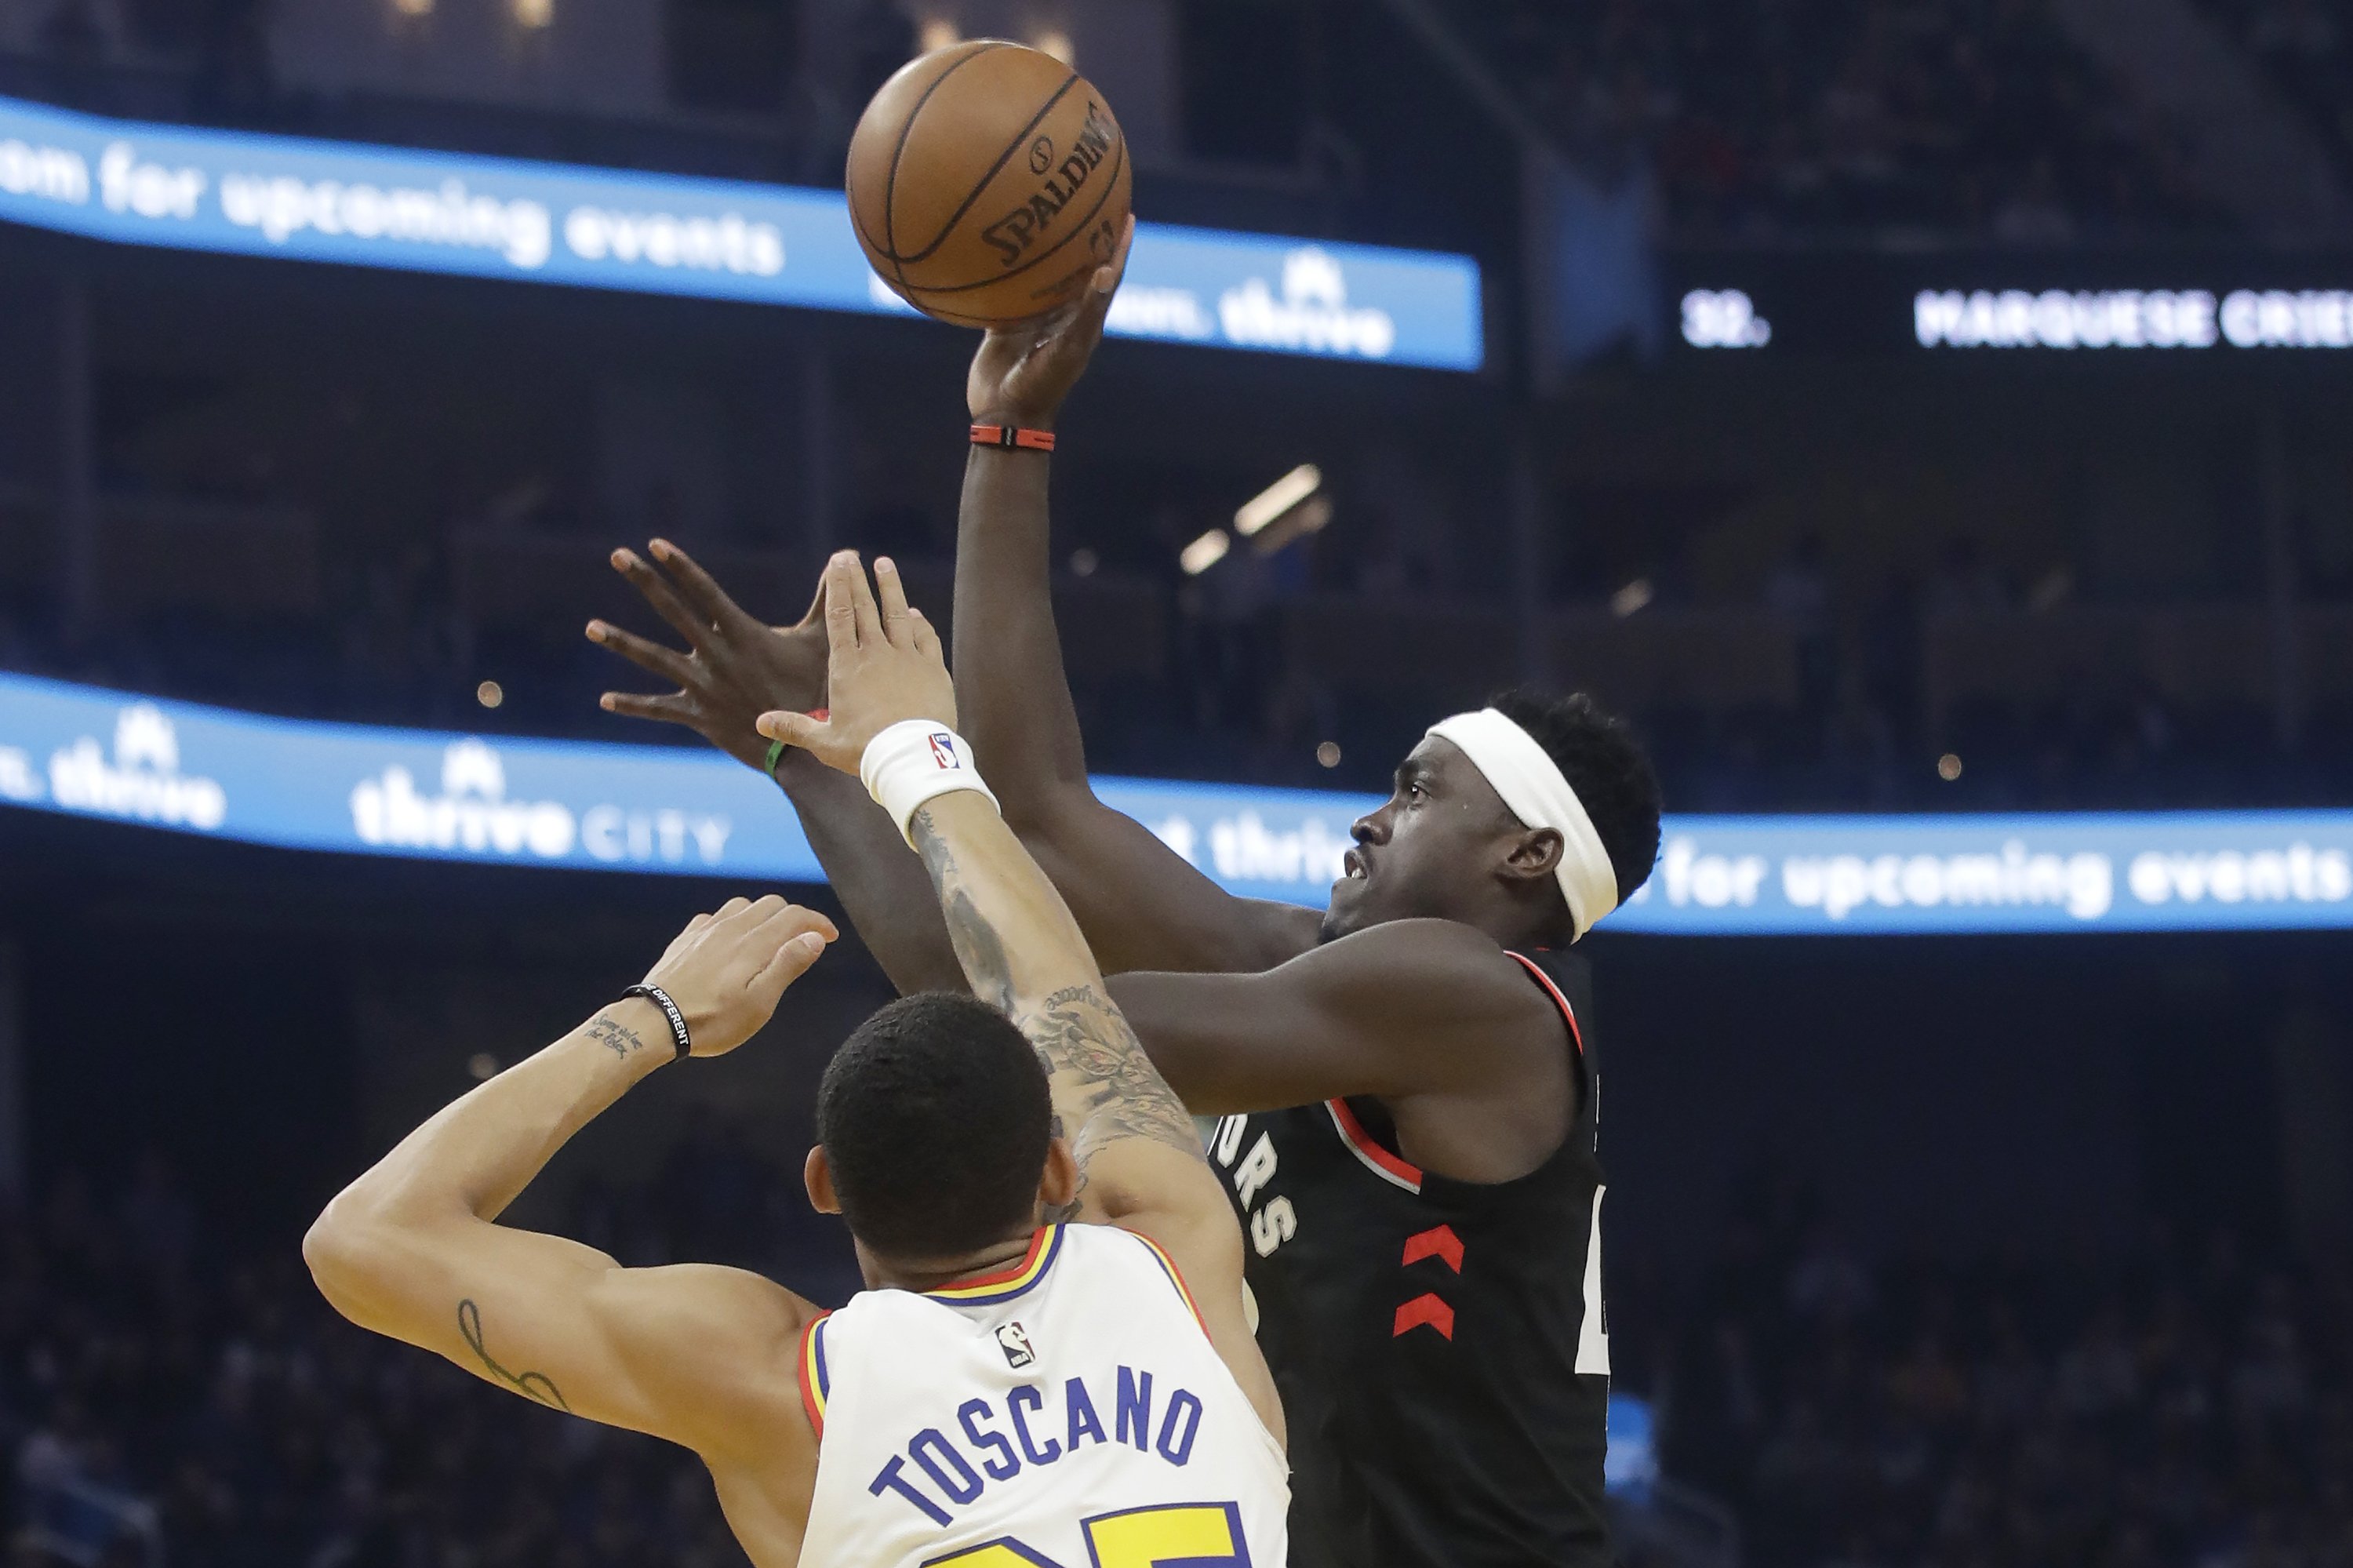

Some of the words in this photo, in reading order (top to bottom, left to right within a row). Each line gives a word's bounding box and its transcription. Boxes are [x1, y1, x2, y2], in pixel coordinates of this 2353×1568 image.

[100, 140, 205, 219] for
[220, 169, 550, 268] upcoming
[565, 206, 783, 277] events
[1914, 288, 2218, 348] MARQUESE
[582, 804, 731, 864] CITY
[1211, 810, 1348, 883] thri
[1664, 835, 1766, 908] for
[1784, 839, 2113, 919] upcoming
[2128, 842, 2352, 904] events
[653, 988, 689, 1045] DIFFERENT
[868, 1365, 1202, 1528] TOSCANO
